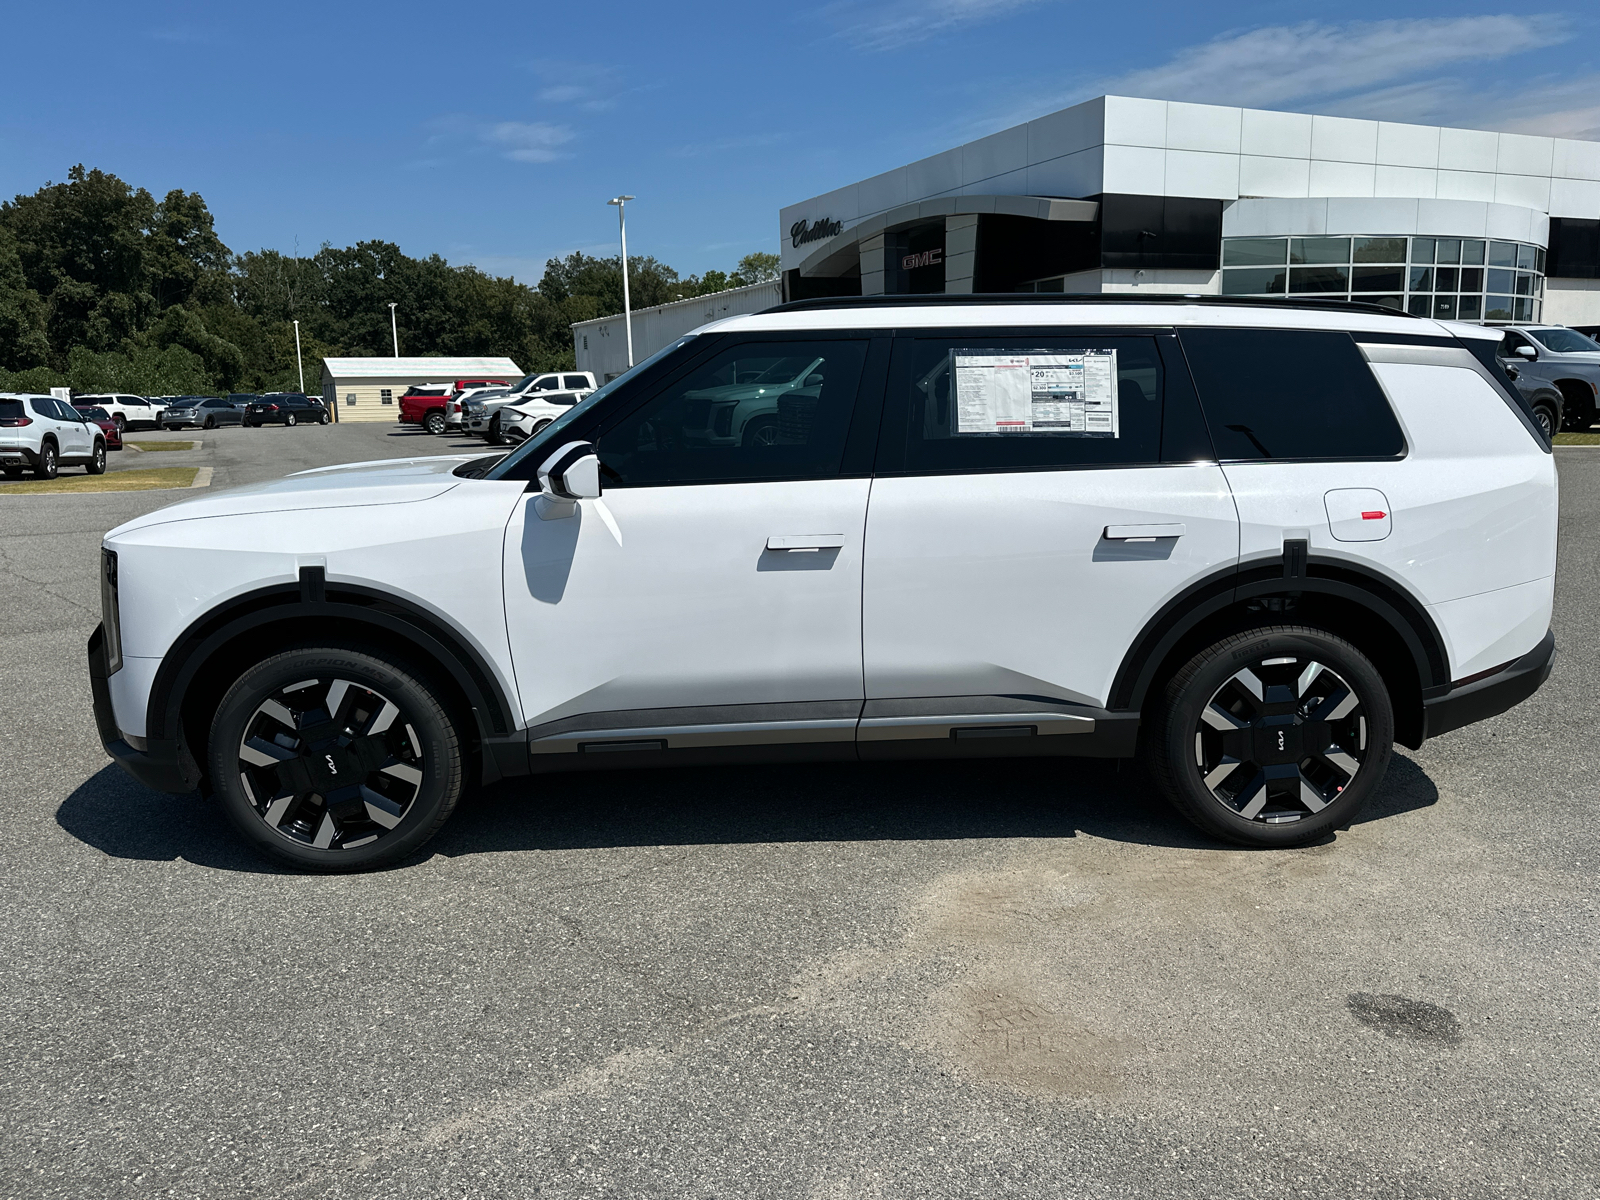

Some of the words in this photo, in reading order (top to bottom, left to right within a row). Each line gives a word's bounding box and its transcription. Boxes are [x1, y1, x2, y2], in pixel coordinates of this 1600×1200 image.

[790, 217, 842, 249] Cadillac
[902, 248, 942, 270] GMC
[273, 658, 358, 677] SCORPION
